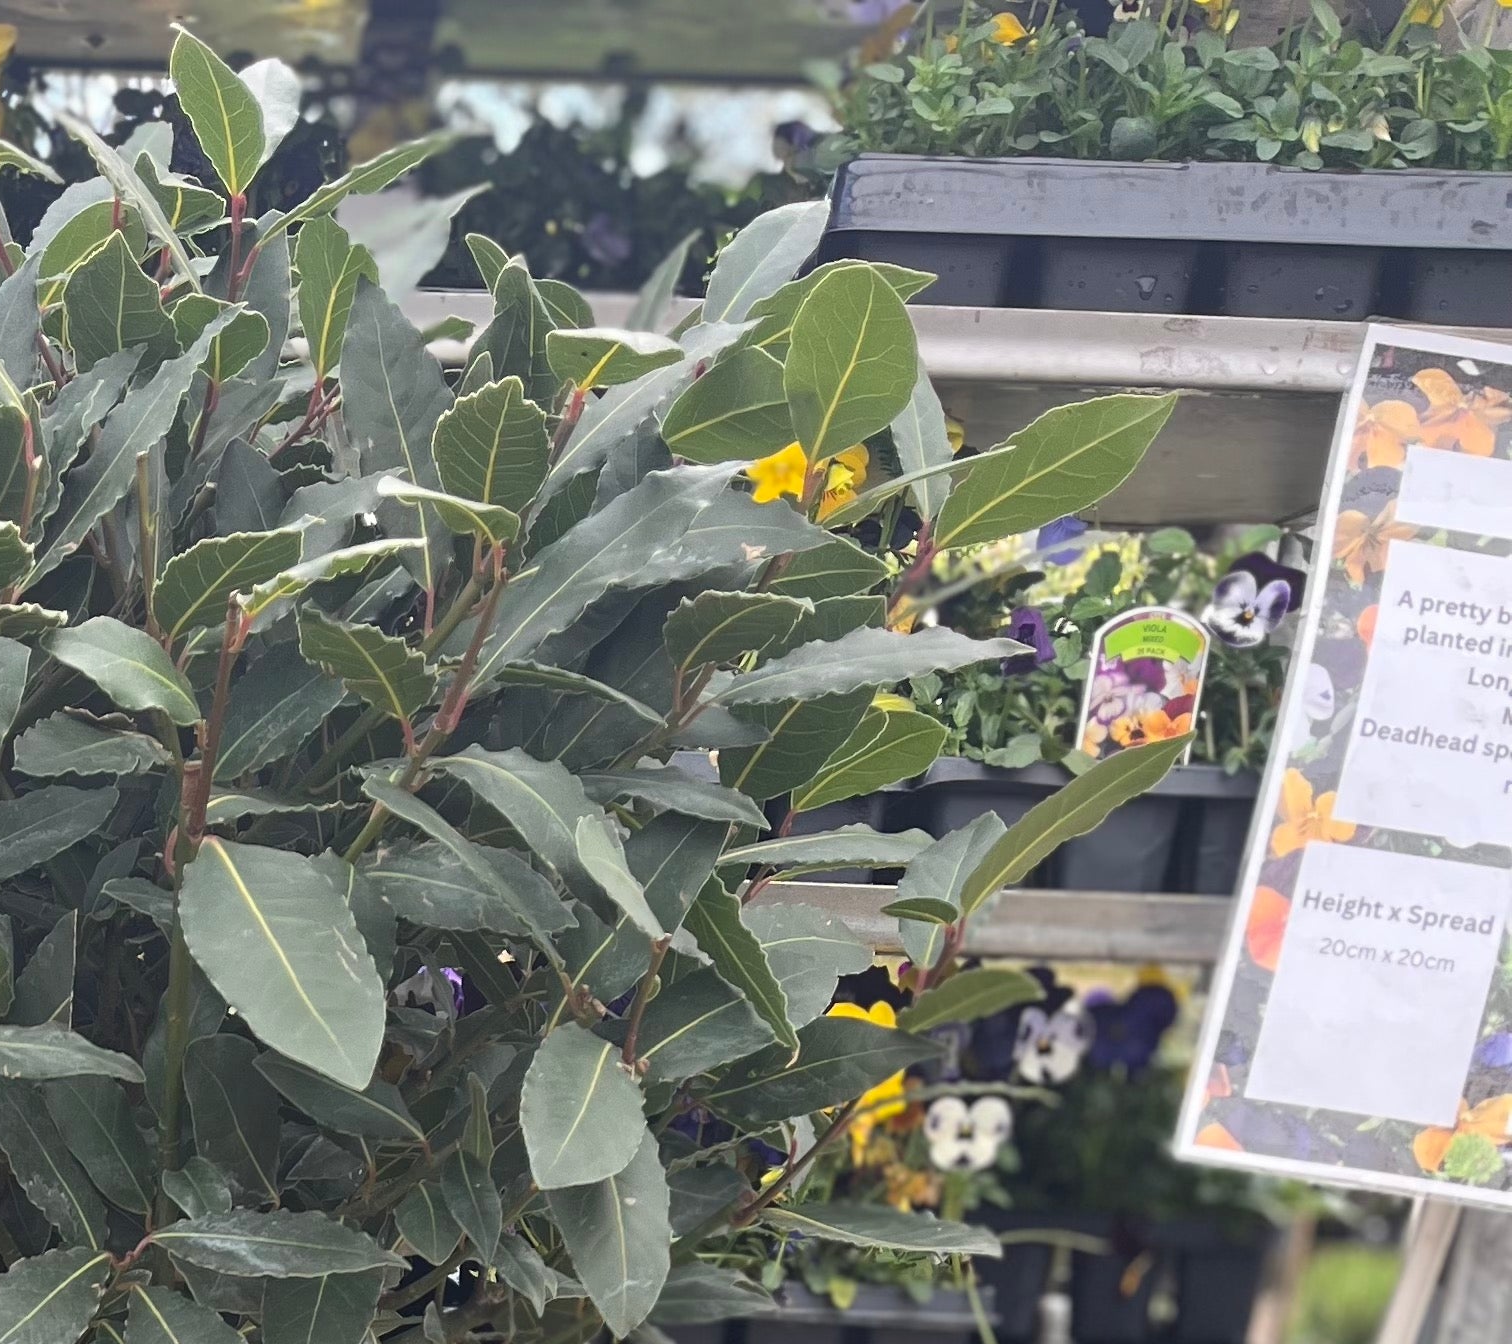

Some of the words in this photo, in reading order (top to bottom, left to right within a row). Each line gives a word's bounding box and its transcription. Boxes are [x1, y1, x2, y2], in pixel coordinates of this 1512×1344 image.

[1397, 590, 1414, 609] A
[1418, 596, 1492, 626] pretty
[1497, 605, 1512, 626] b
[1143, 623, 1167, 633] VIOLA
[1402, 625, 1494, 655] planted
[1467, 666, 1512, 697] Lon
[1359, 717, 1479, 754] Deadhead
[1482, 740, 1512, 764] sp
[1302, 889, 1384, 921] Height
[1387, 905, 1402, 922] x
[1407, 905, 1496, 936] Spread
[1319, 937, 1376, 961] 20cm
[1381, 950, 1392, 963] x
[1397, 948, 1455, 973] 20cm
